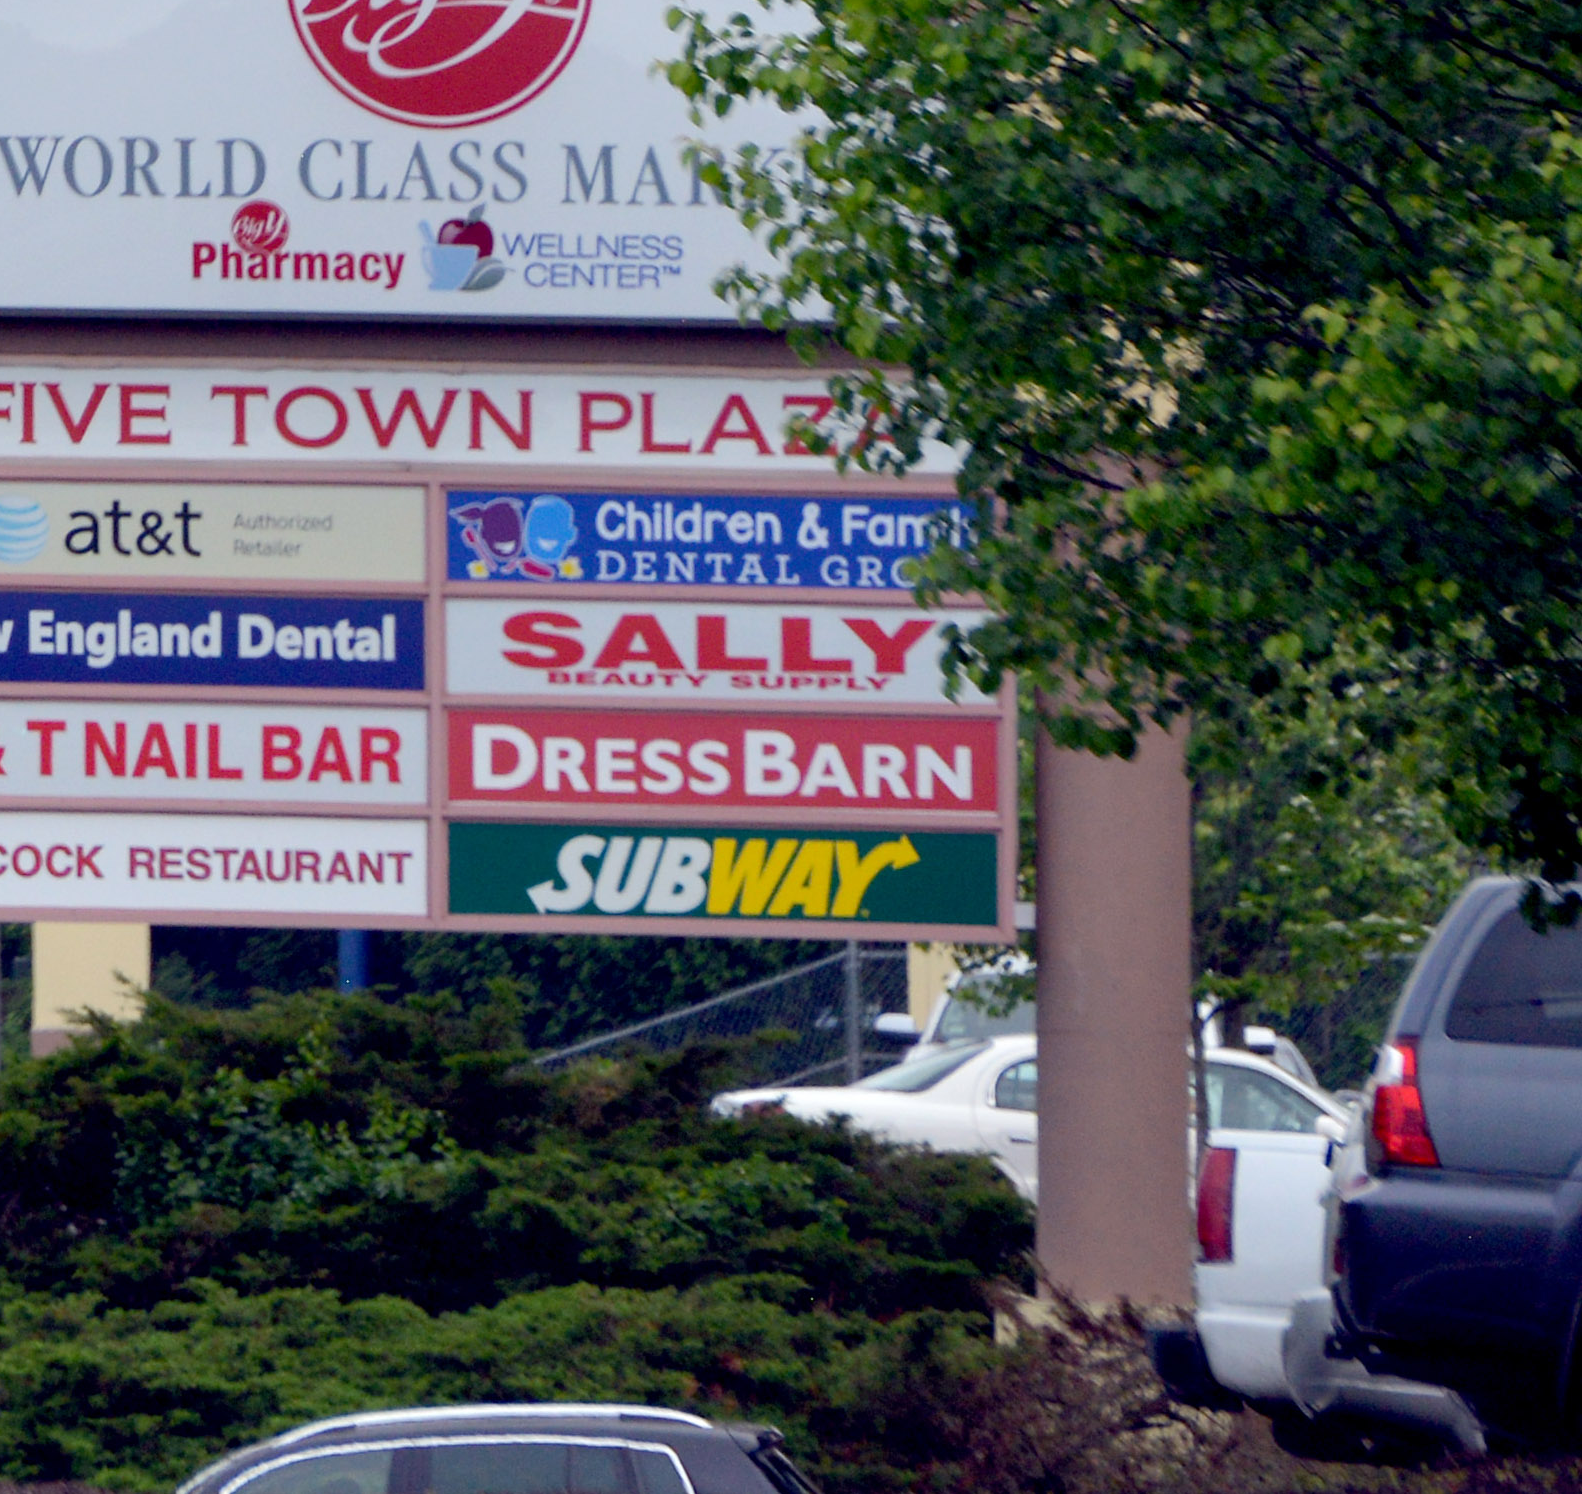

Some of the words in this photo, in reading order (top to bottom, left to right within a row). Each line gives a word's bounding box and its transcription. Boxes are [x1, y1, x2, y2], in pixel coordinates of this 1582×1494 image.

[299, 138, 529, 204] CLASS
[192, 242, 405, 290] Pharmacy
[502, 232, 684, 261] WELLNESS
[210, 385, 534, 452] TOWN
[63, 499, 203, 557] at&t
[233, 512, 333, 532] Authorized
[233, 538, 302, 557] Retailer
[595, 501, 782, 545] Children
[797, 502, 829, 549] &
[842, 505, 979, 548] Faml
[596, 550, 801, 587] DENTAL
[28, 609, 223, 668] England
[238, 612, 397, 662] Dental
[501, 611, 937, 675] SALLY
[548, 670, 708, 688] BEAUTY
[730, 673, 892, 692] SUPPLY
[26, 720, 67, 776] T
[84, 721, 243, 781] NAIL
[262, 724, 402, 784] BAR
[471, 722, 732, 796] DRESS
[744, 728, 973, 802] BARN
[128, 846, 413, 885] RESTAURANT
[527, 833, 920, 918] SUBWAY
